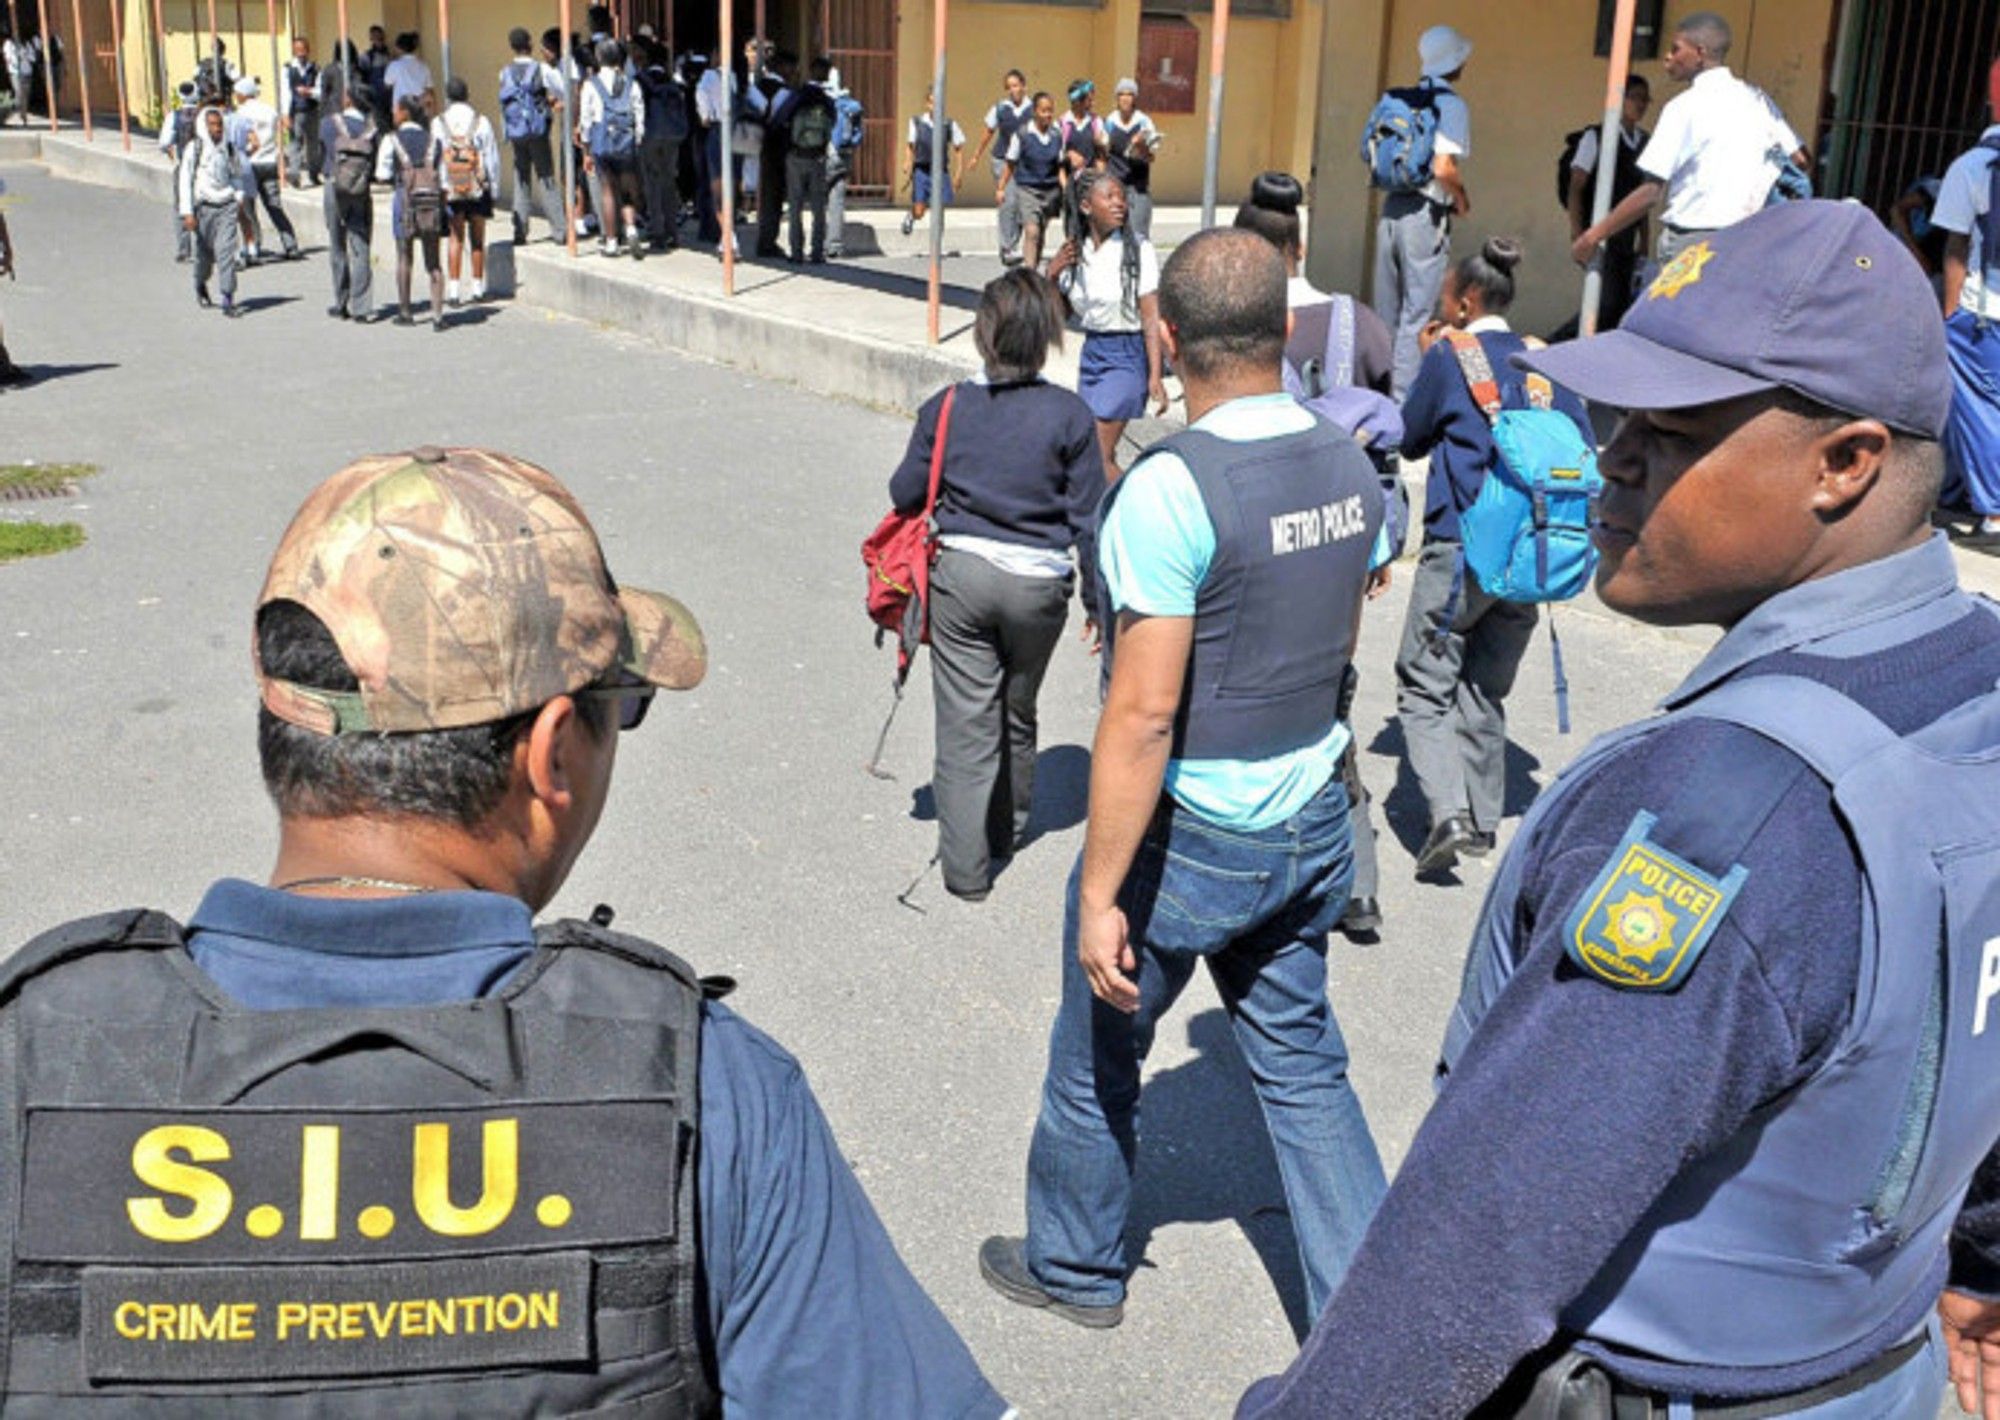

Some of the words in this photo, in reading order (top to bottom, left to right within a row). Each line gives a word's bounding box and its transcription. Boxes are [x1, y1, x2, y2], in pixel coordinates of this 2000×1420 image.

[1270, 507, 1320, 555] METRO
[1321, 494, 1366, 544] POLICE
[1625, 855, 1713, 916] POLICE
[126, 1117, 572, 1242] S.I.U.
[114, 1301, 257, 1341] CRIME
[277, 1291, 559, 1341] PREVENTION
